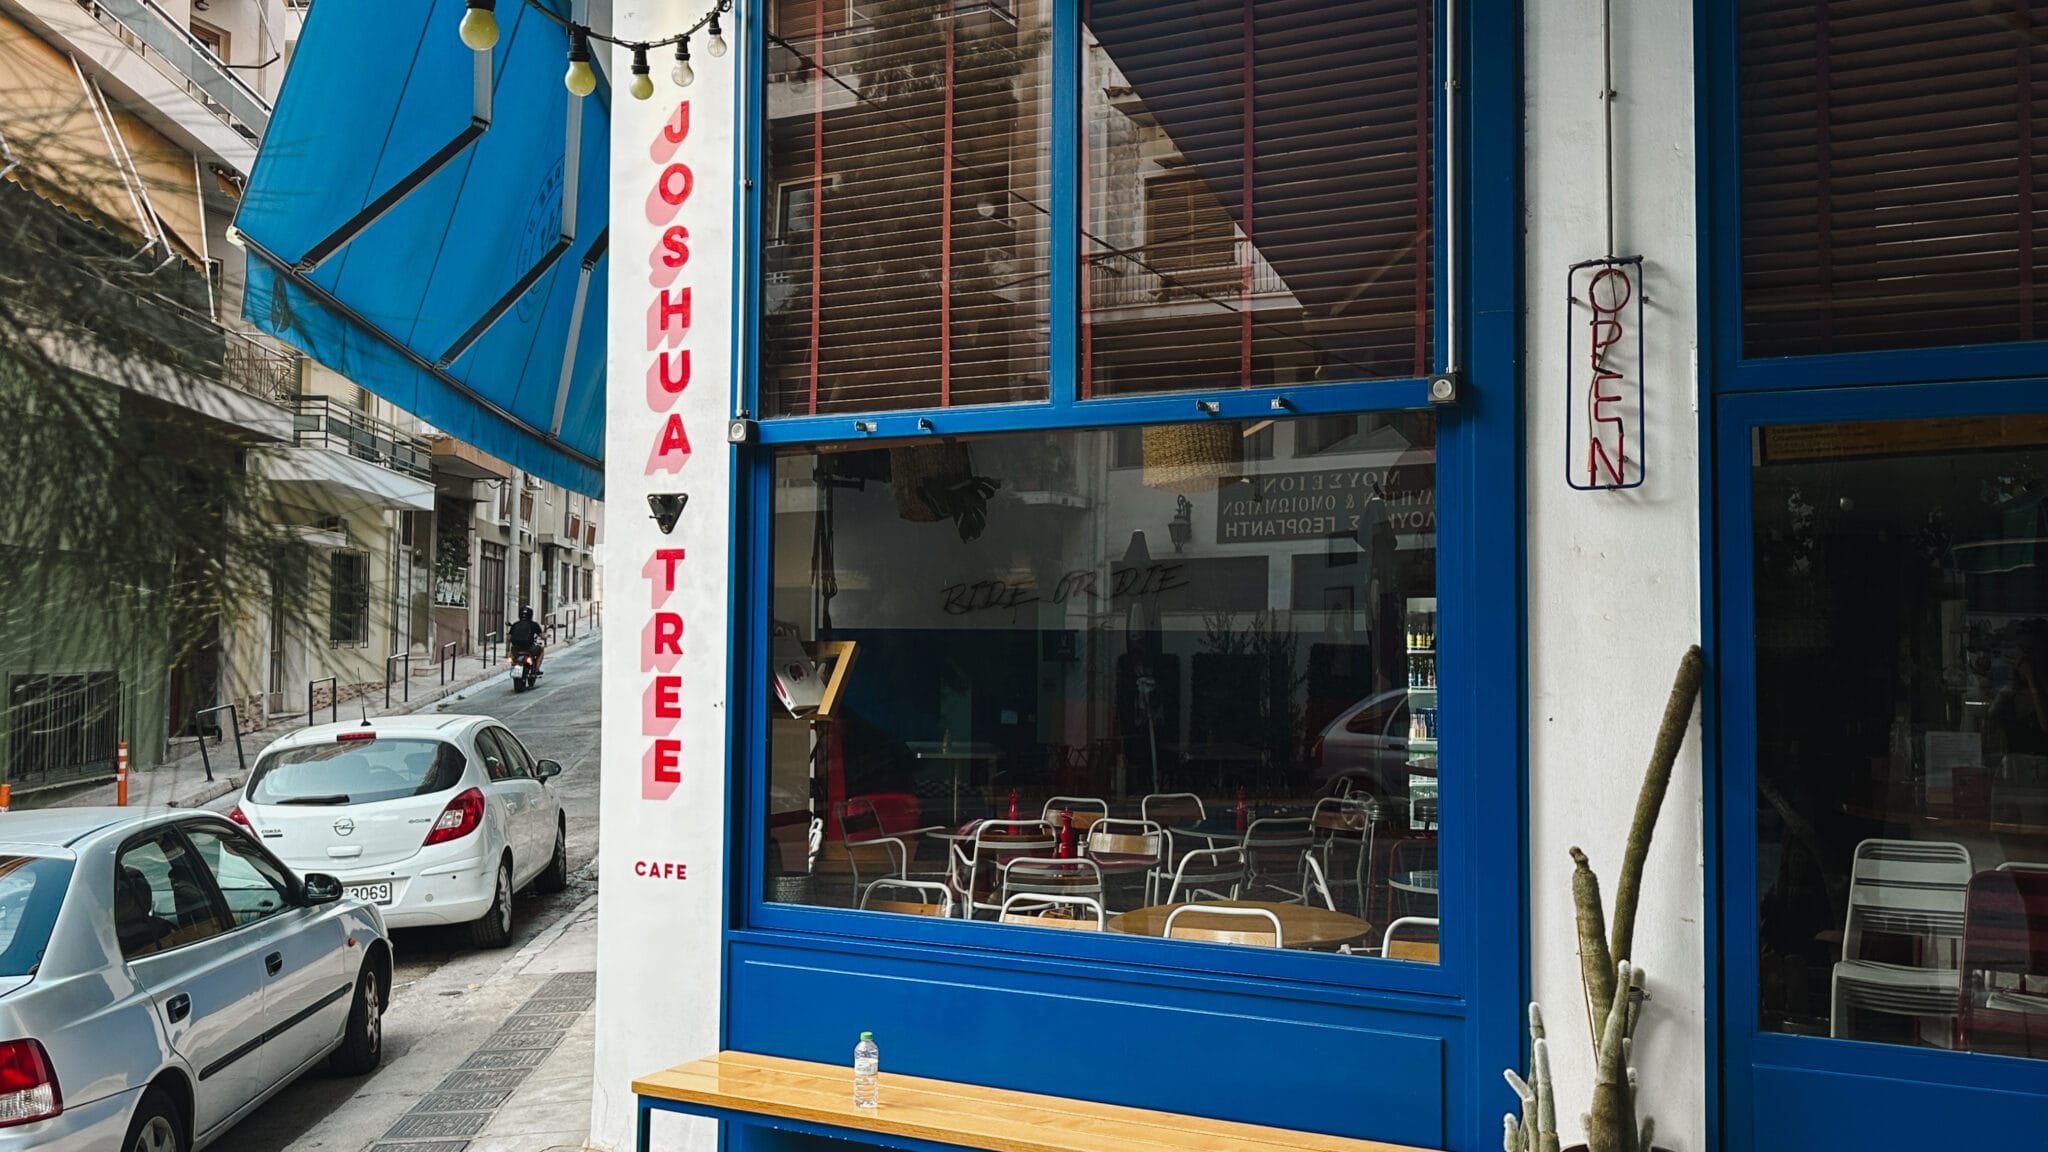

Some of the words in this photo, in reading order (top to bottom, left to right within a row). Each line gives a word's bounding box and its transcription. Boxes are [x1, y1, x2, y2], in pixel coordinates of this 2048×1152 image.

[644, 100, 694, 476] JOSHUA
[1589, 268, 1631, 486] OPEN
[641, 548, 686, 801] TREE
[1051, 570, 1099, 605] OR
[1106, 564, 1191, 599] DIE
[634, 861, 687, 880] CAFE
